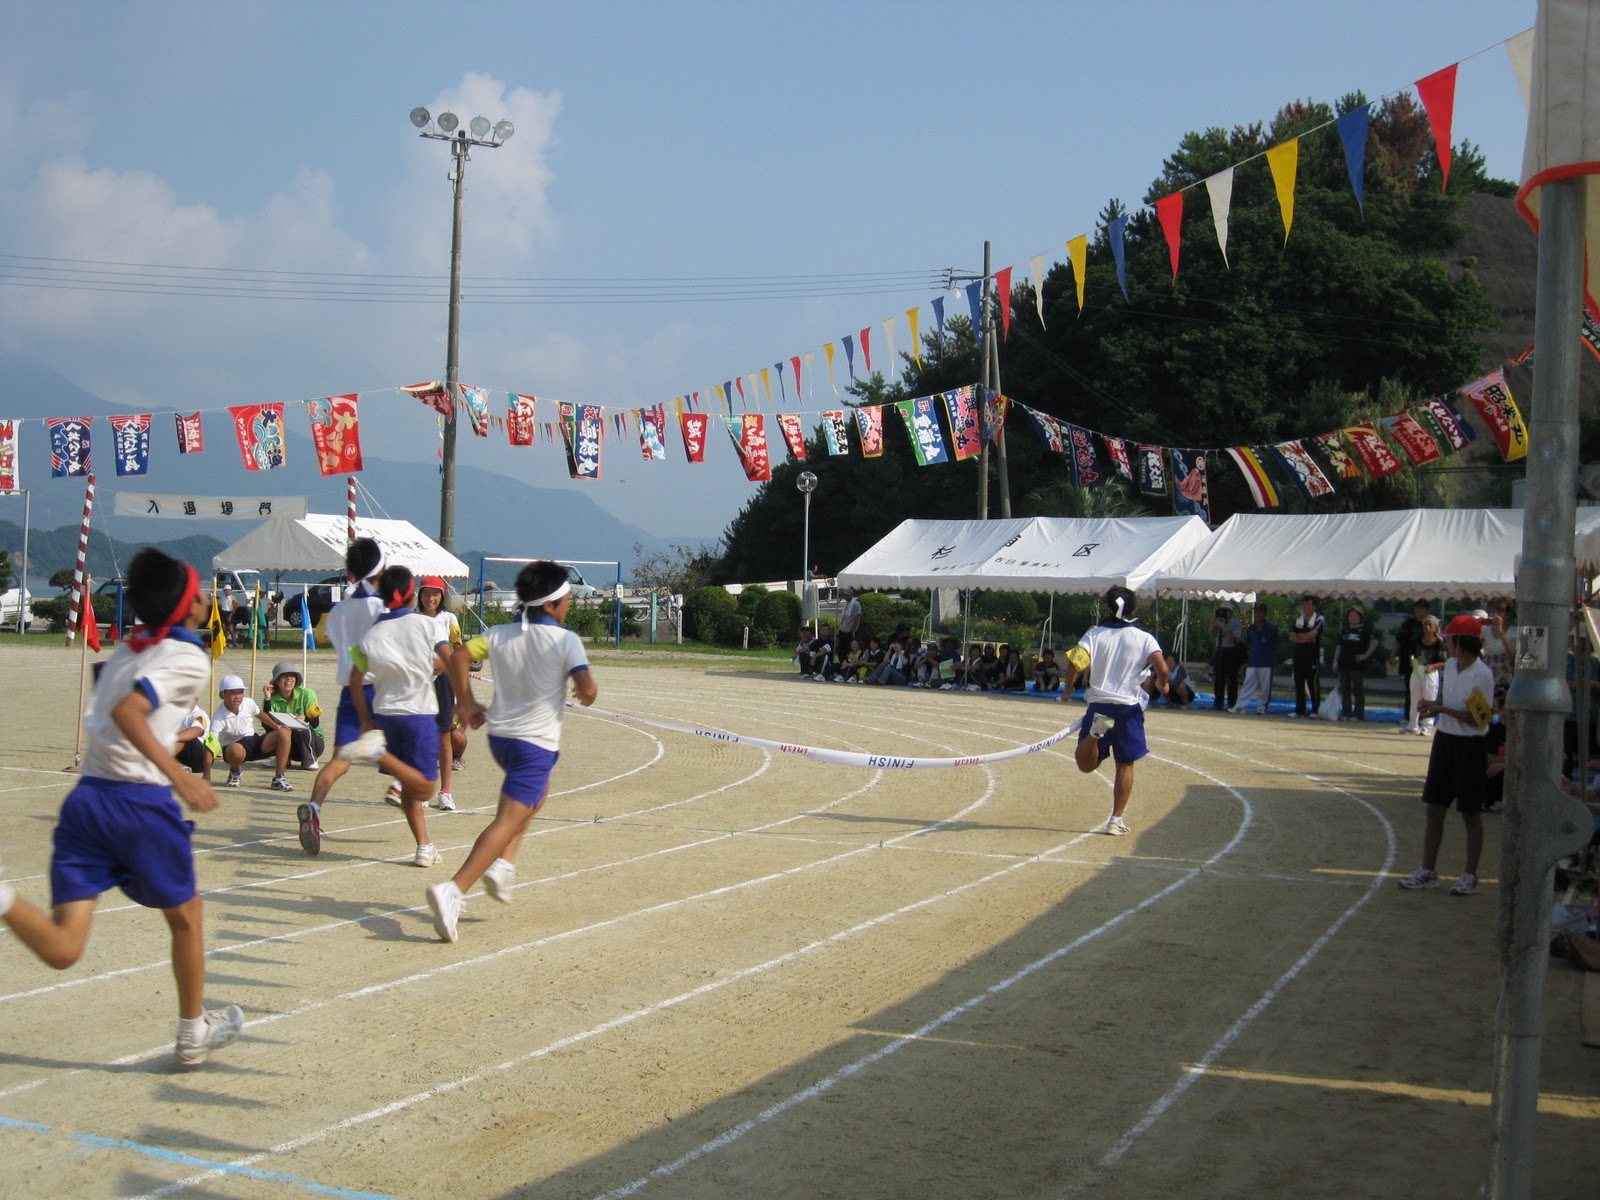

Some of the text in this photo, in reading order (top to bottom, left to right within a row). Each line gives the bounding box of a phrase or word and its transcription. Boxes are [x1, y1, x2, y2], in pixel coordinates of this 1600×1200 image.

[147, 500, 272, 516] 入退場門
[695, 730, 739, 743] FINISH
[1027, 734, 1062, 754] FINISH
[868, 756, 914, 769] FINISH
